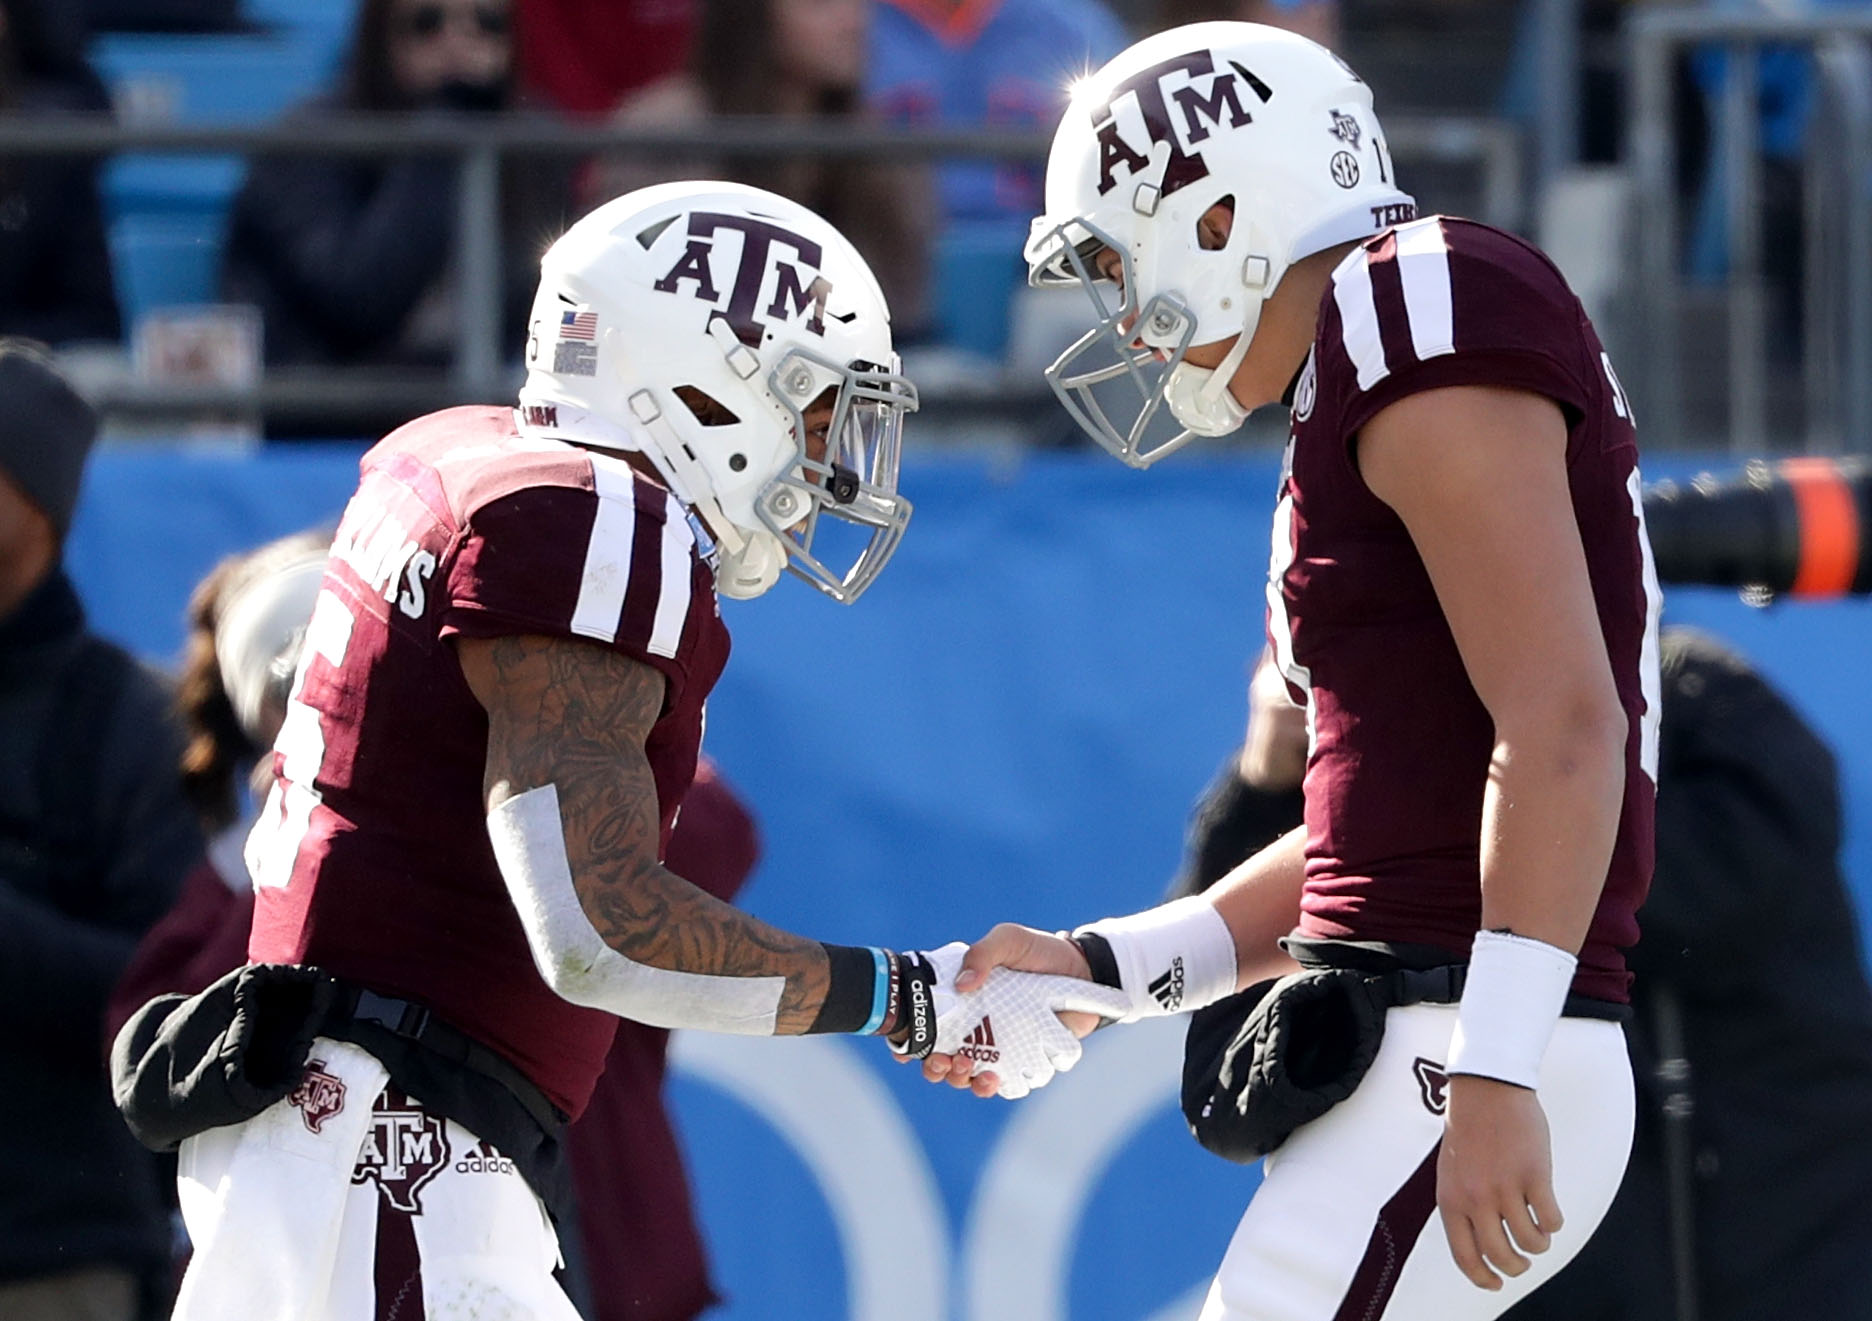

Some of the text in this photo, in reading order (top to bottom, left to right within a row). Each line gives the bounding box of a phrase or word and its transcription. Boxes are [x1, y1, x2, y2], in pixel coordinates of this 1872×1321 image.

[1372, 138, 1387, 184] 1
[1370, 203, 1418, 228] TEXA
[653, 211, 833, 349] ATM
[889, 984, 899, 1015] PLAY
[911, 979, 928, 1042] adizero
[455, 1156, 514, 1176] adidas
